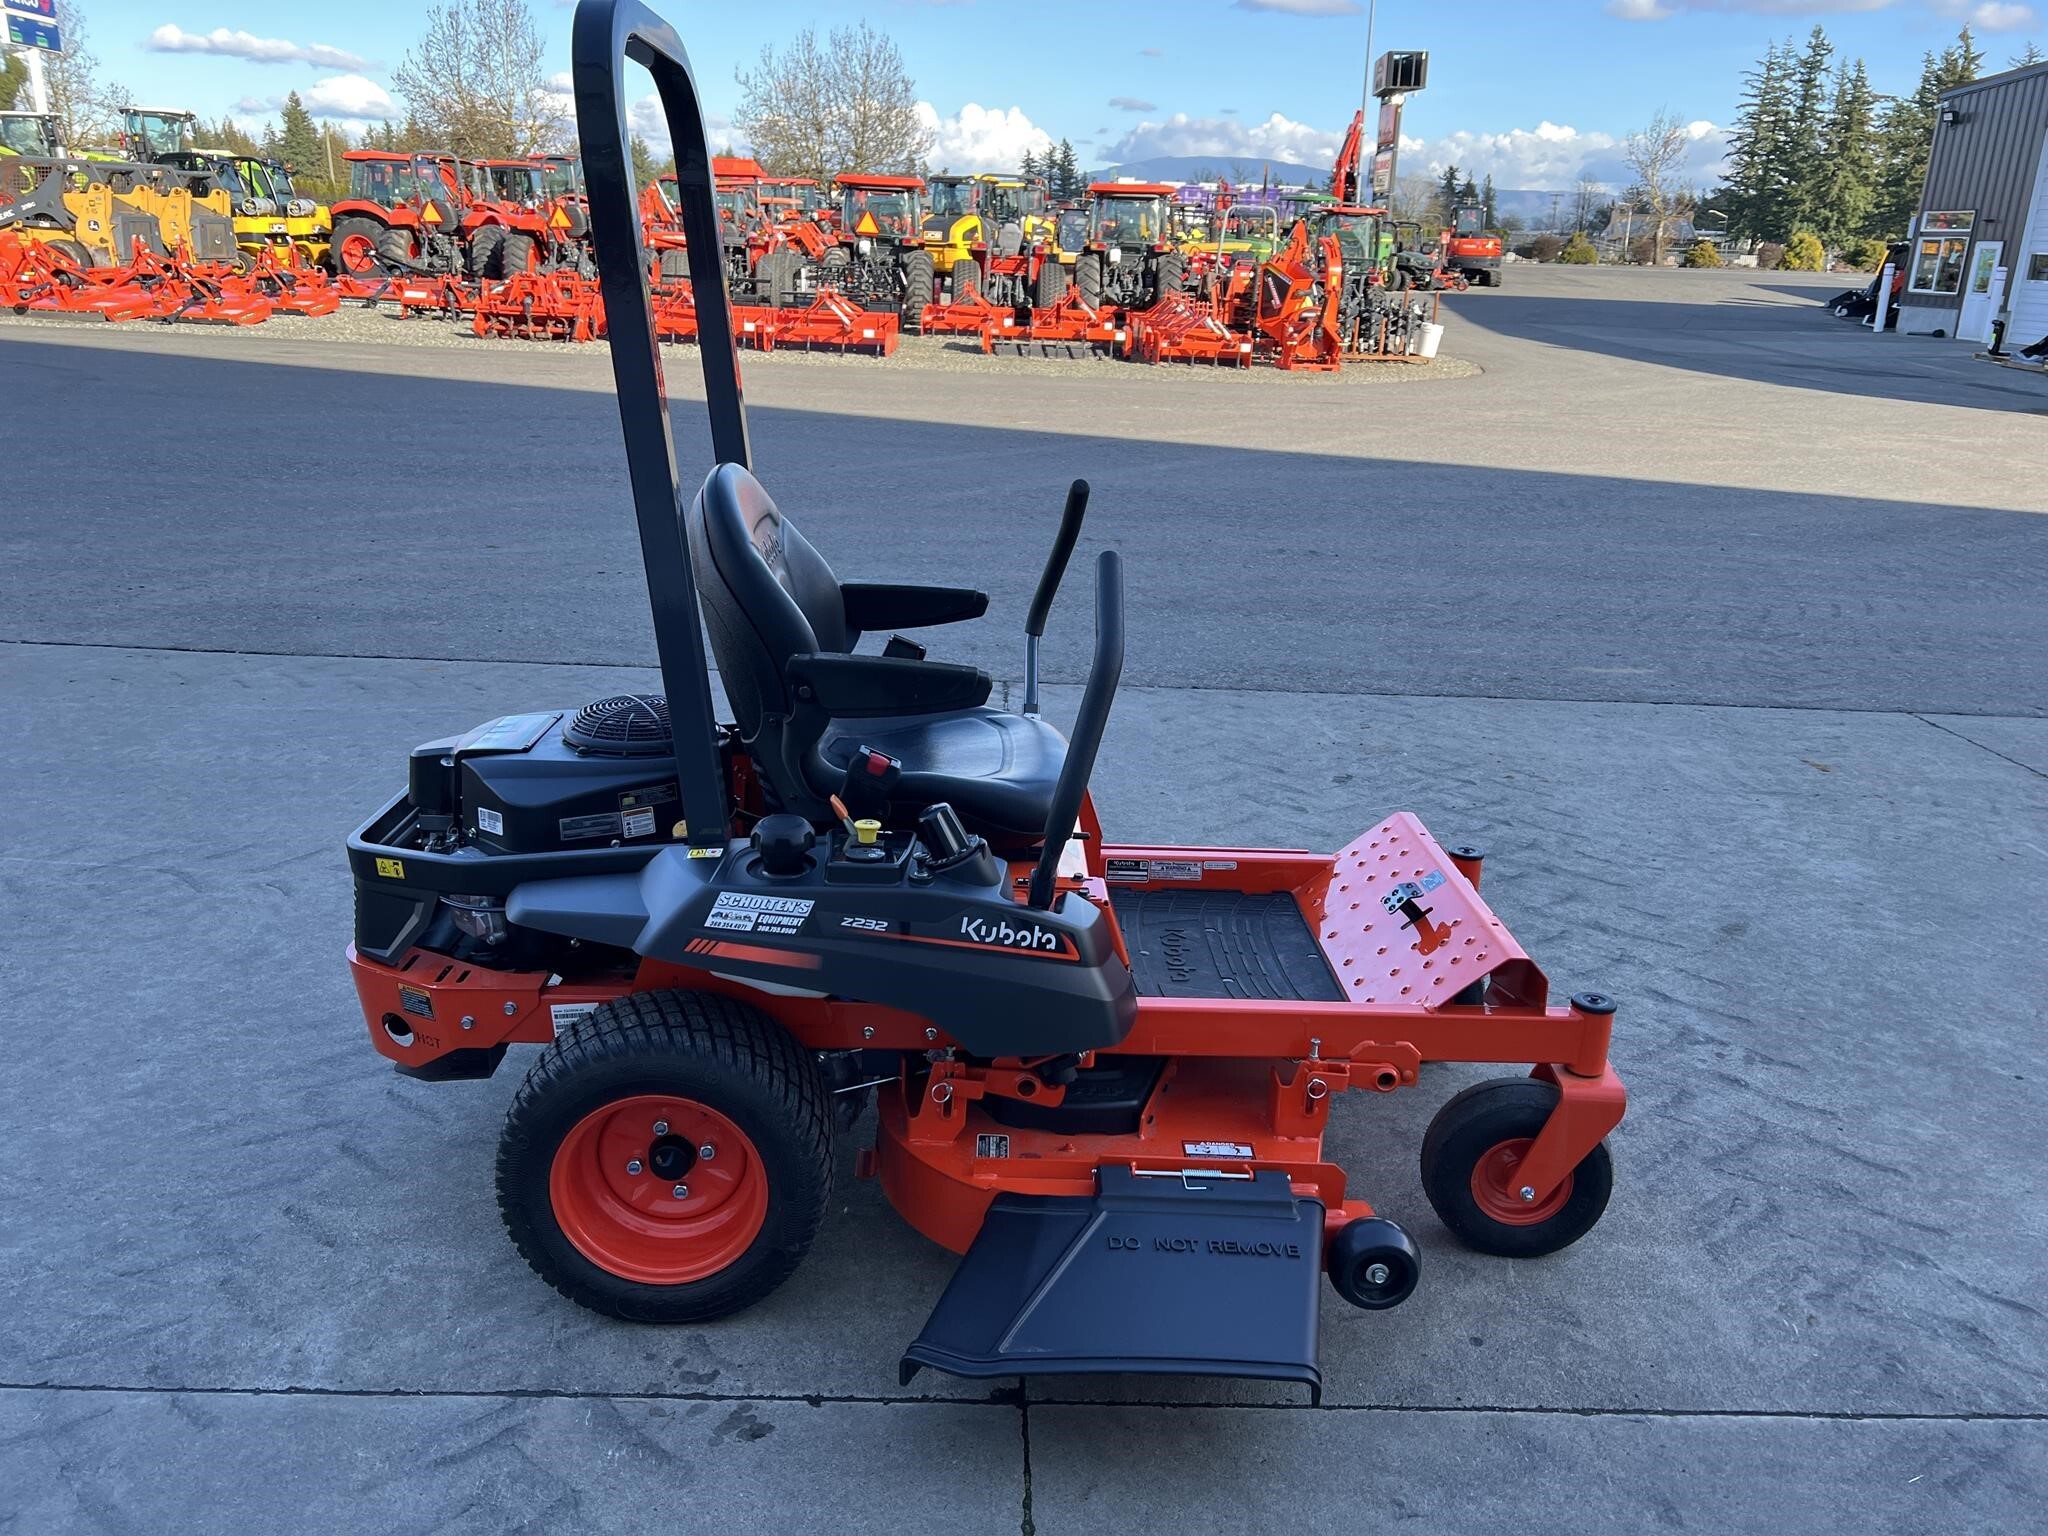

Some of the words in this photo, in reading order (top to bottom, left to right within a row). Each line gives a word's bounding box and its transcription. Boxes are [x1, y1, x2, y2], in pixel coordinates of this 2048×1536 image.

[717, 894, 810, 914] SCHOLTEN'S
[758, 914, 805, 927] EQUIPMENT
[841, 917, 888, 932] Z232
[960, 916, 1057, 950] Kubota
[1160, 928, 1197, 982] Kubota
[1107, 1236, 1141, 1251] DO
[1153, 1237, 1199, 1253] NOT
[1206, 1240, 1300, 1259] REMOVE
